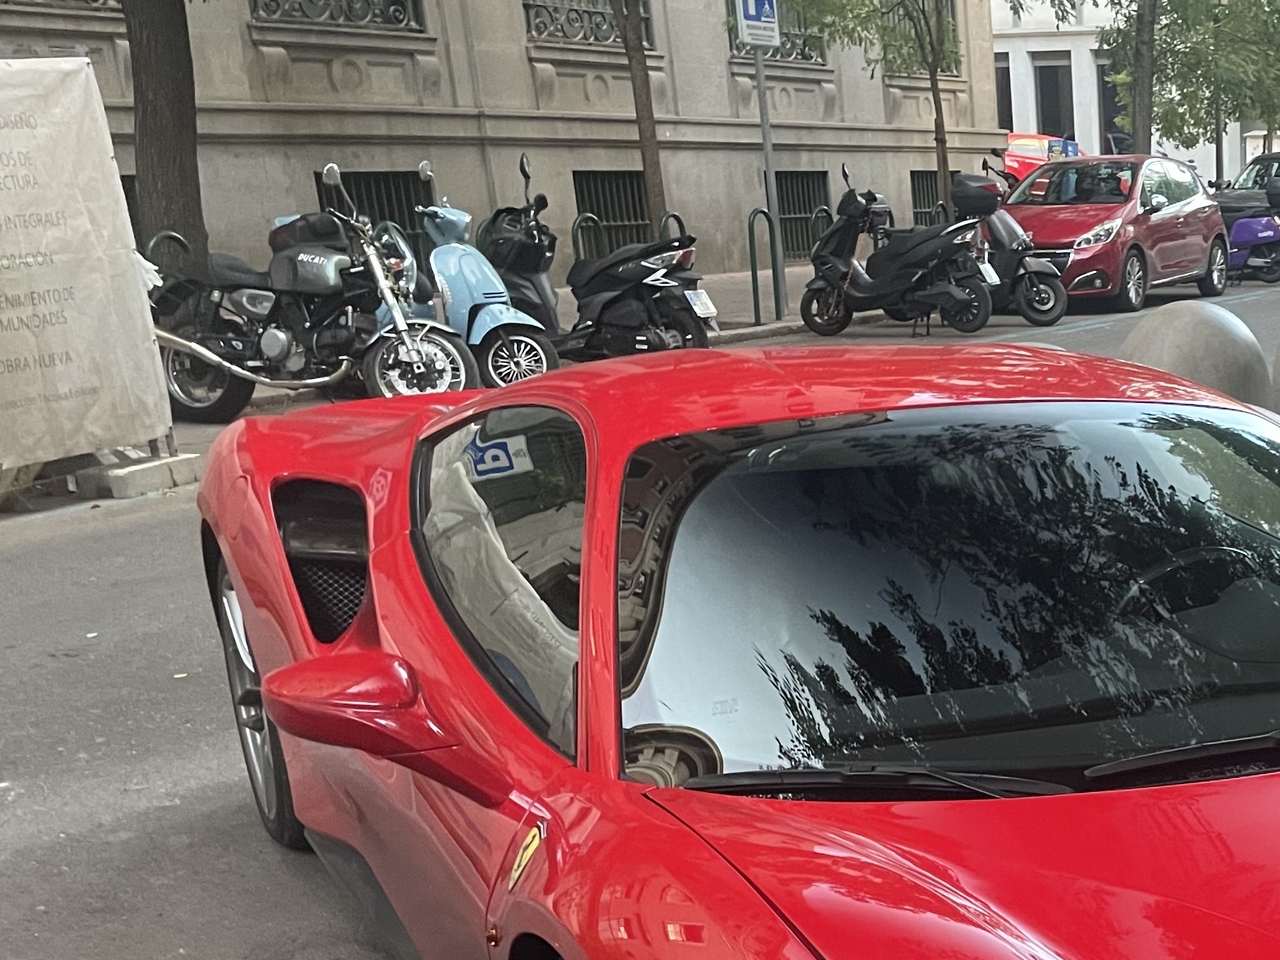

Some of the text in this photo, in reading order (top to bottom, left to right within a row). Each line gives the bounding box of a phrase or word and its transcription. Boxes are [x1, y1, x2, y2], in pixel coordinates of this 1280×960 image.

[17, 150, 34, 167] DE
[4, 210, 68, 230] INTEGRALES
[298, 253, 328, 265] DUCATI
[61, 286, 76, 302] DE
[32, 350, 73, 370] NUEVA
